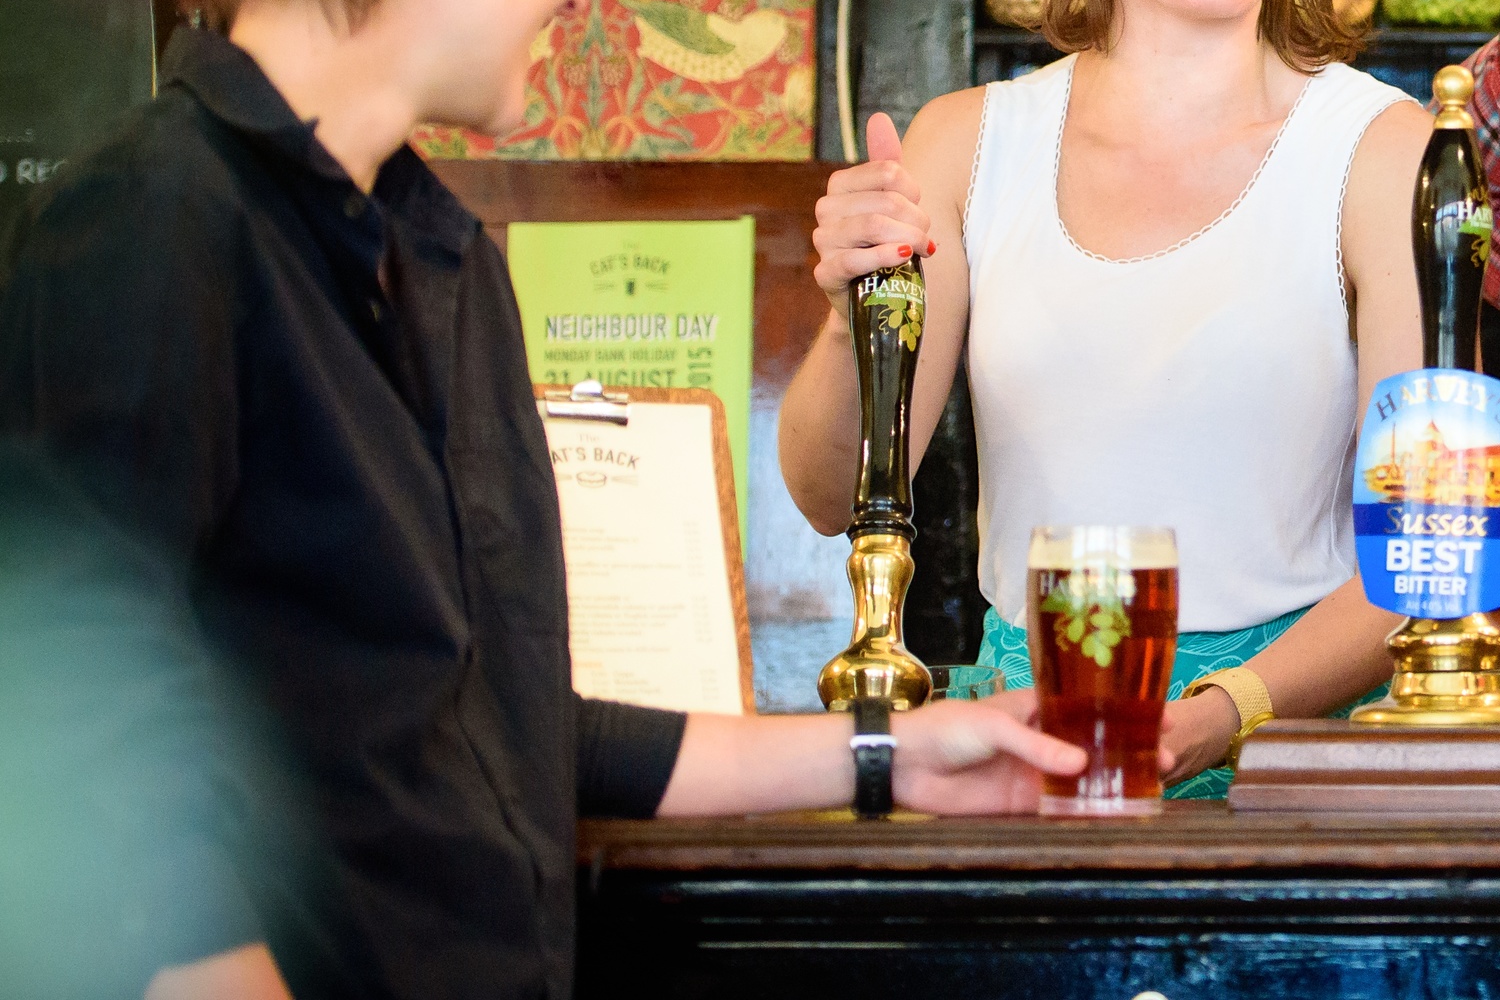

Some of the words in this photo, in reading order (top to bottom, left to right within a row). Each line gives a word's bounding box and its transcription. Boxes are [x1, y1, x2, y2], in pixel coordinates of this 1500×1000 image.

[545, 313, 668, 341] NEIGHBOUR
[676, 313, 717, 342] DAY
[551, 446, 587, 465] AT'S
[593, 447, 640, 470] BACK
[1383, 505, 1489, 537] Sussex
[1386, 539, 1482, 575] BEST
[1394, 576, 1468, 597] BITTER
